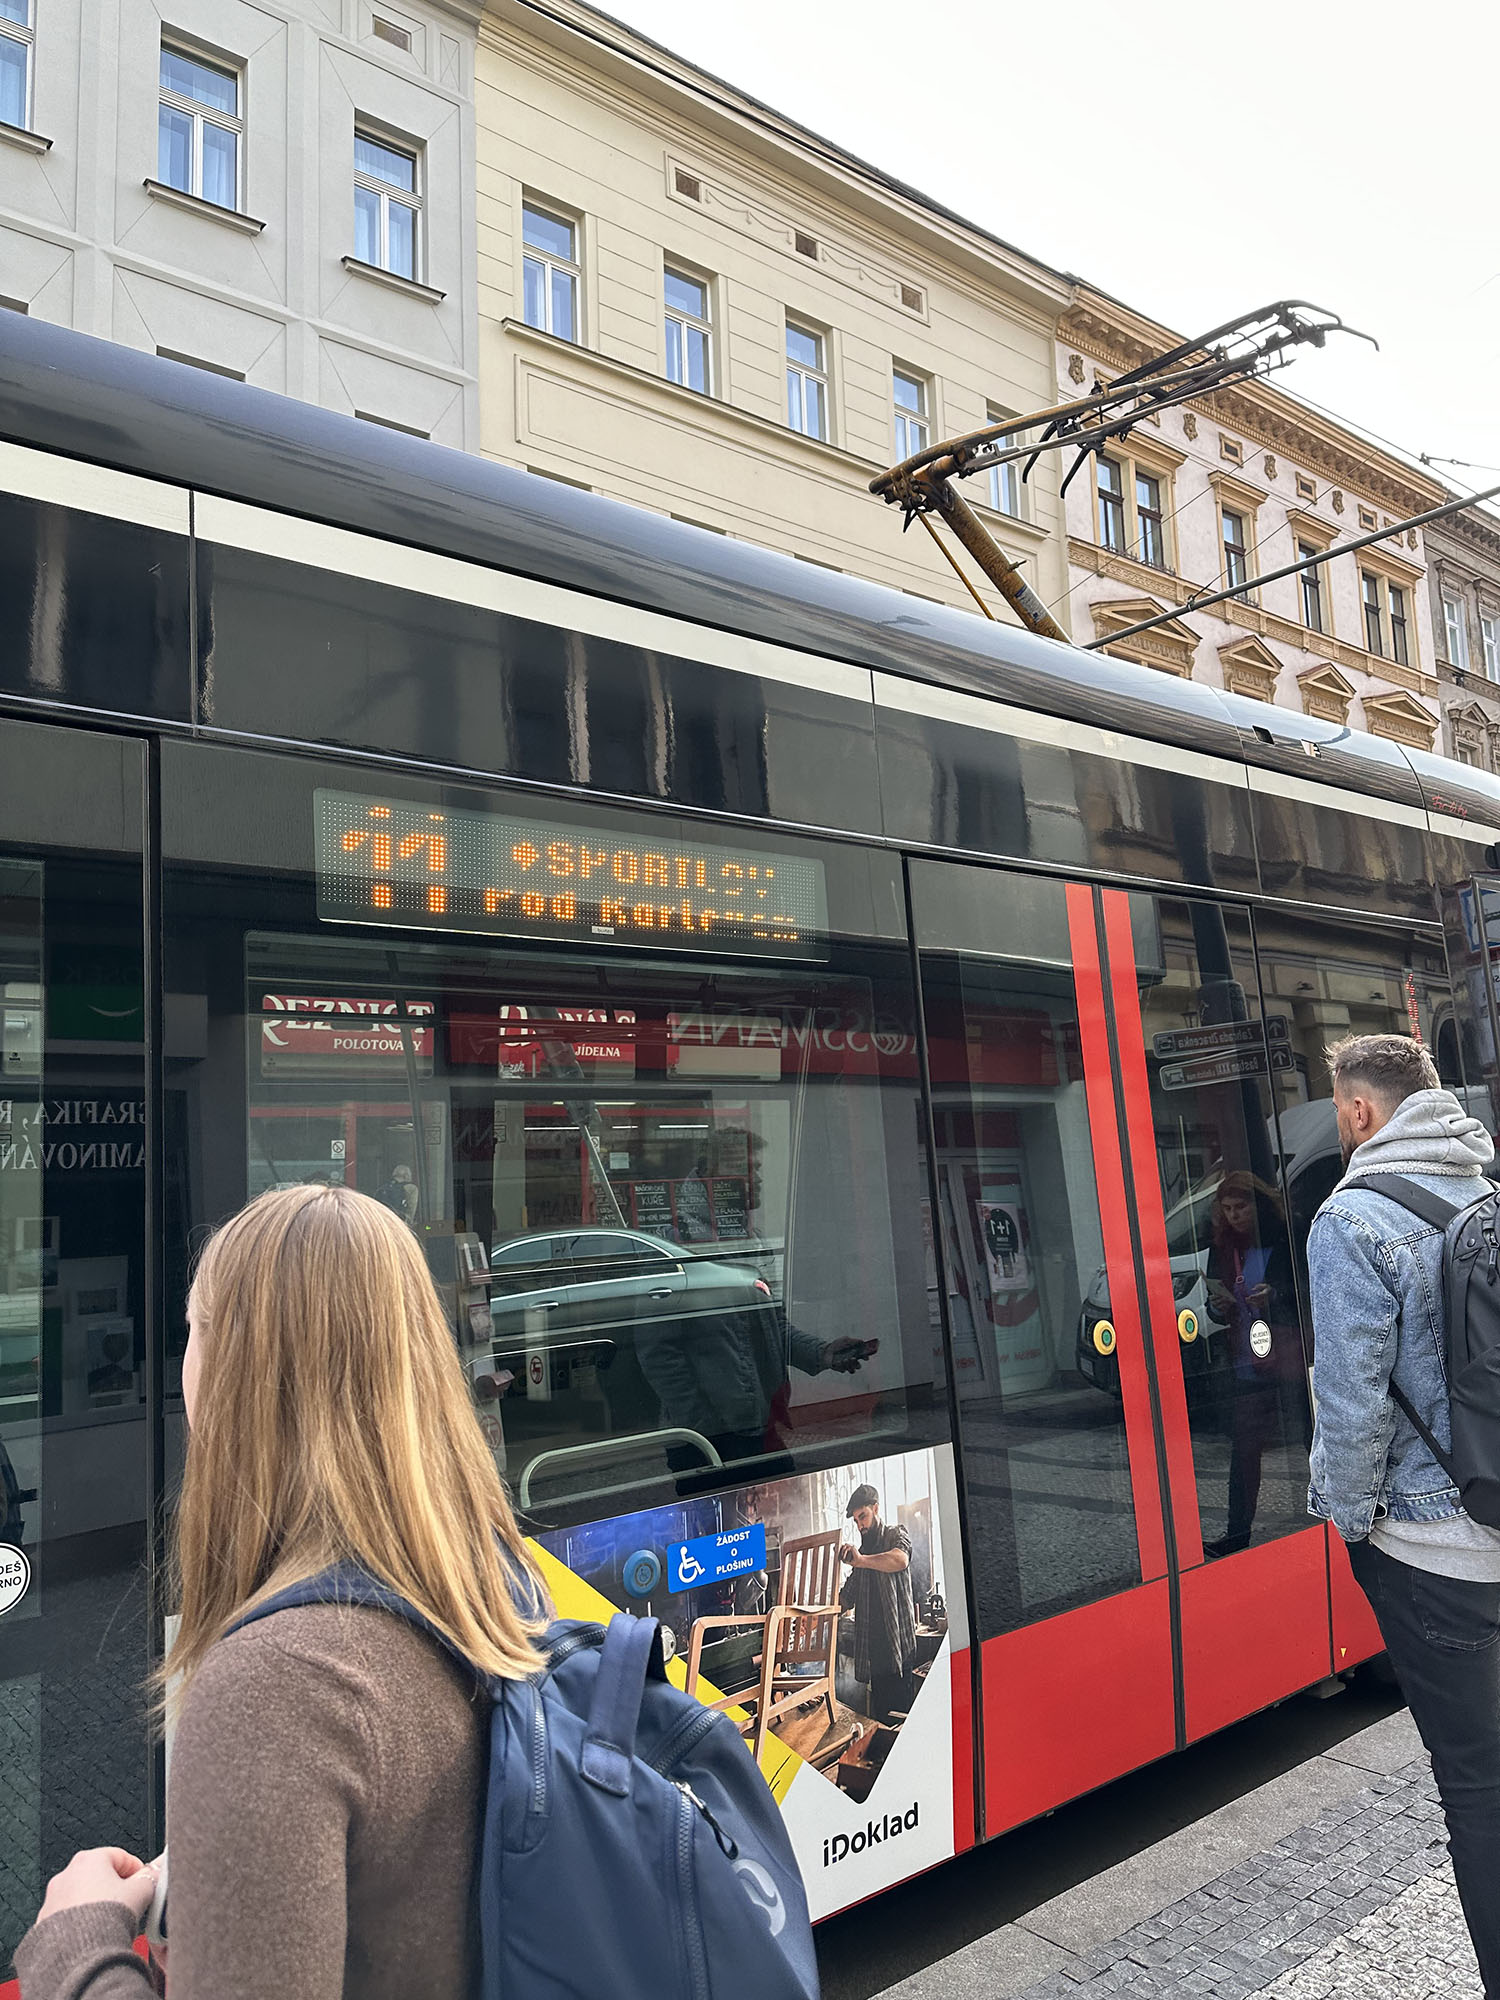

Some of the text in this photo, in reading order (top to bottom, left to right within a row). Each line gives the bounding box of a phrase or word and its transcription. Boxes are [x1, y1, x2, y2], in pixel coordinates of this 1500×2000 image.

[342, 806, 445, 913] 11
[333, 1038, 422, 1051] POLOTOVAY
[574, 1044, 621, 1057] JÍDELNA
[641, 1194, 665, 1206] KUŘE
[715, 1530, 751, 1547] ŽÁDOST
[715, 1557, 754, 1575] PLOŠINU
[823, 1801, 919, 1868] iDoklad
